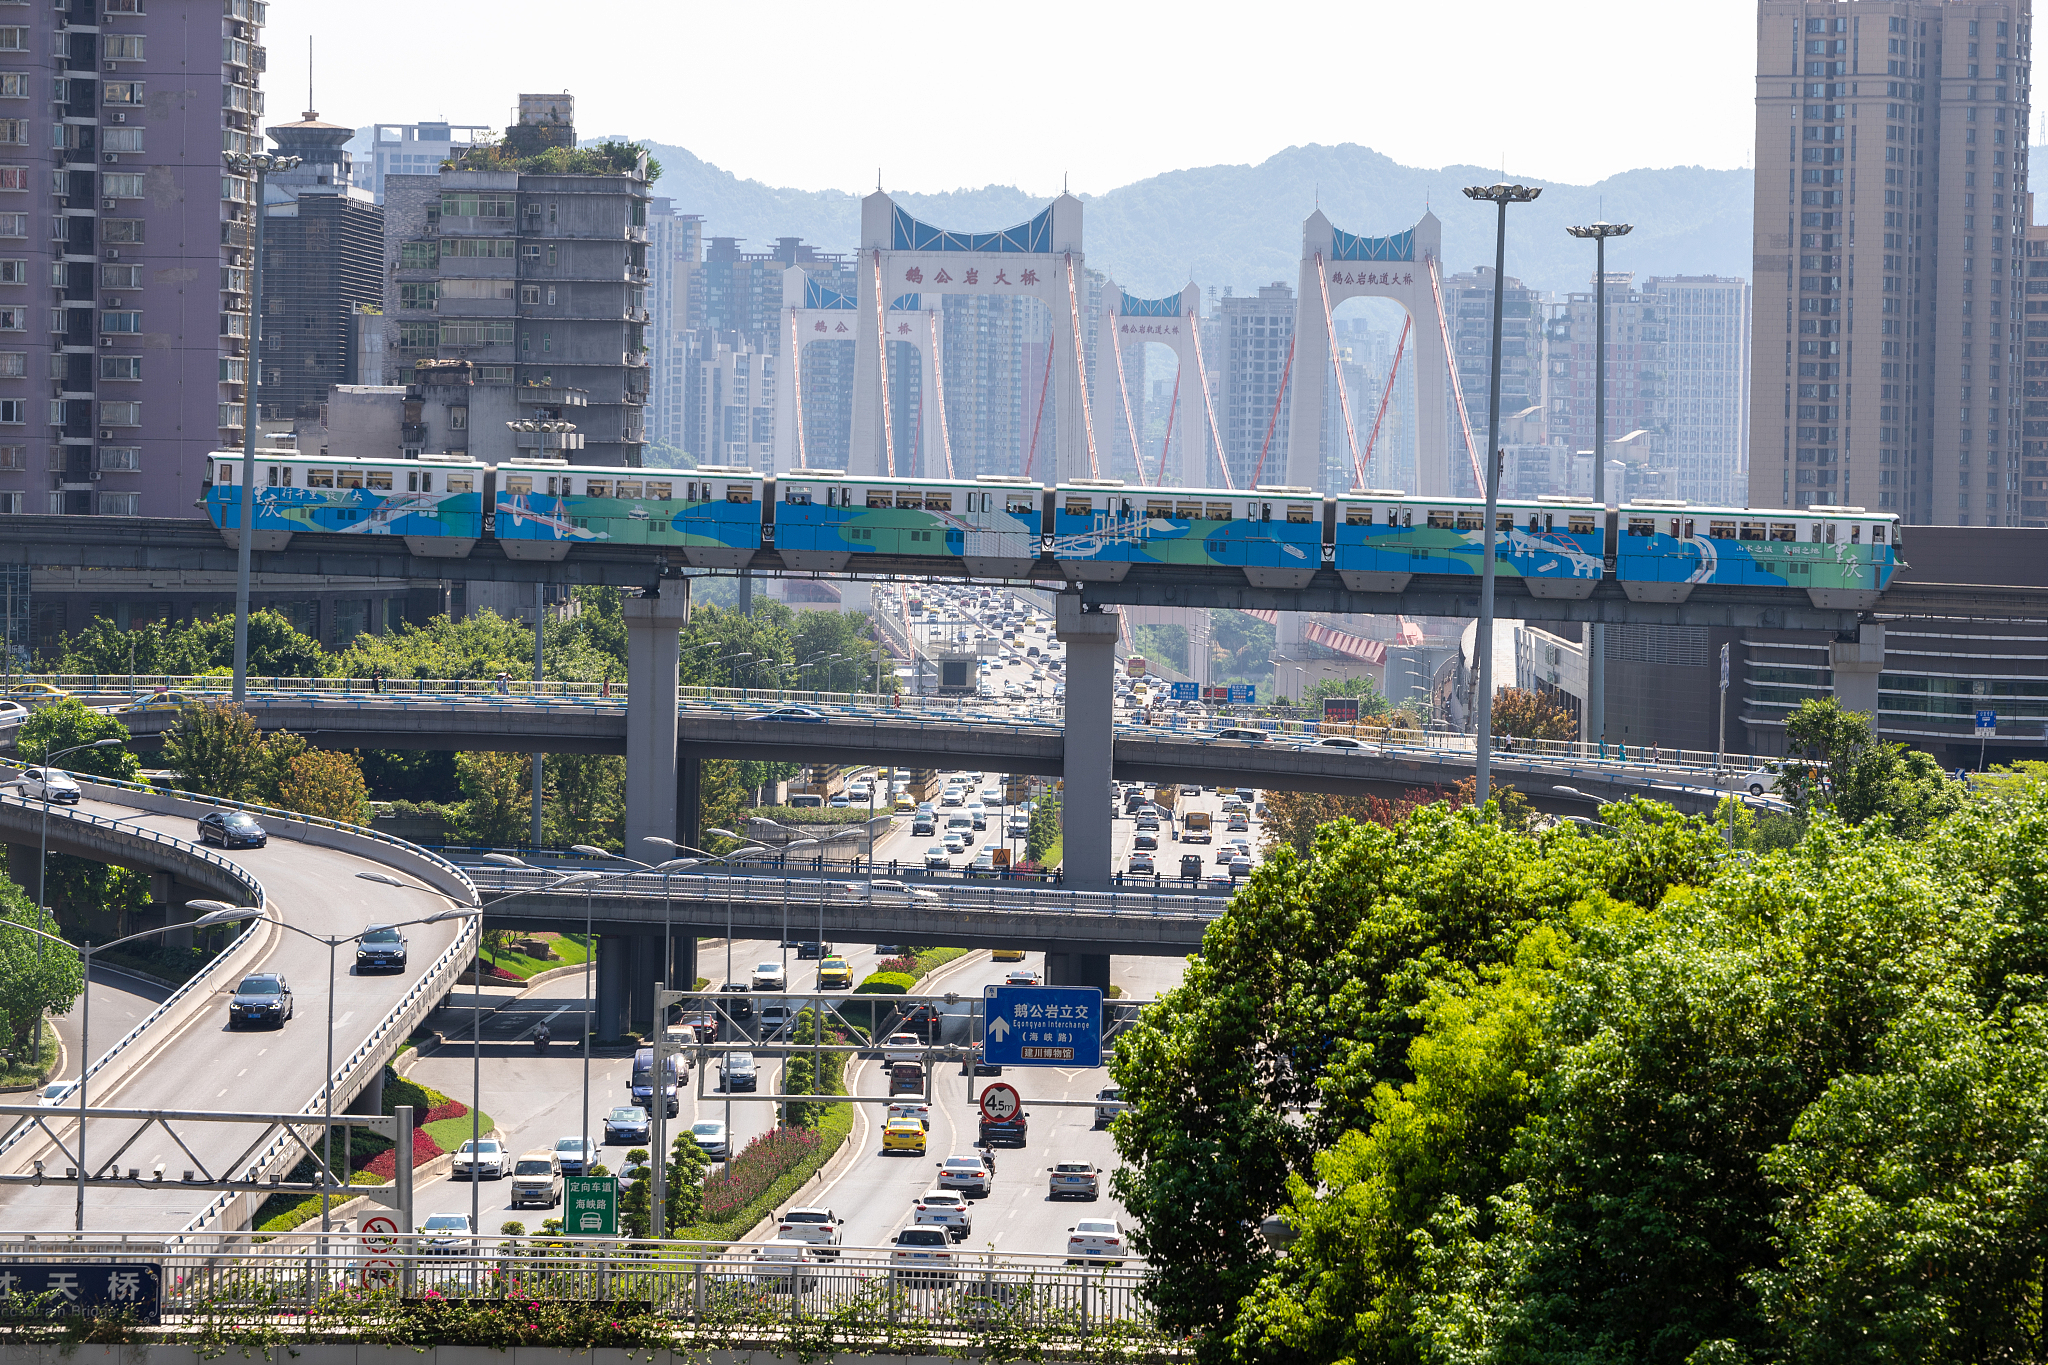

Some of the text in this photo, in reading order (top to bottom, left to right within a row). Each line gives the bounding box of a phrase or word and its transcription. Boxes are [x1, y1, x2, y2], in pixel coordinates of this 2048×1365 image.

[905, 266, 1041, 286] 鹅公岩大桥
[1332, 271, 1414, 286] 鹅公岩轨道大桥
[1827, 537, 1864, 579] 重庆
[1013, 1003, 1089, 1019] 鹅公岩立交
[1013, 1020, 1090, 1031] Egongyan Interchange
[1024, 1048, 1072, 1059] 建川博物馆
[985, 1094, 1014, 1111] 4.5m
[570, 1181, 612, 1193] 定向车道
[576, 1199, 607, 1210] 海峡路
